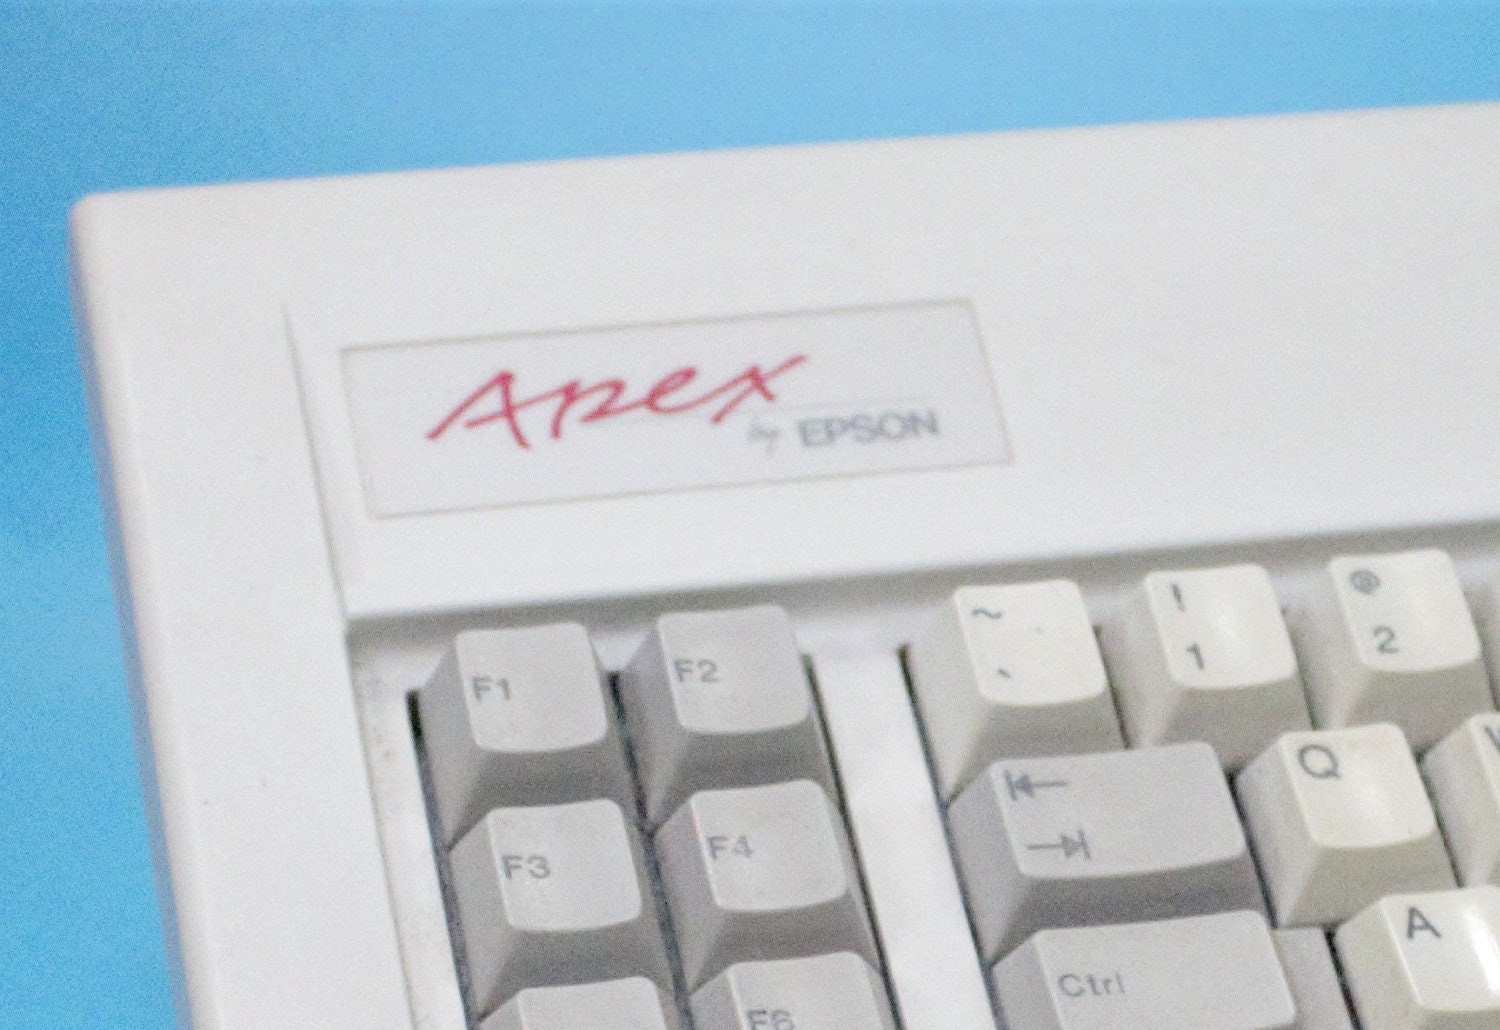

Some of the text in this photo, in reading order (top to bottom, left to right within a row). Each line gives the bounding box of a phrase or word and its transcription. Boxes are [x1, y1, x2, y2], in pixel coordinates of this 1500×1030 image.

[427, 355, 809, 450] Apex
[800, 407, 940, 449] EPSON
[1374, 626, 1398, 655] 2
[1186, 644, 1205, 670] 1
[674, 658, 718, 684] F2
[472, 677, 511, 703] F1
[1300, 743, 1341, 780] Q
[706, 834, 756, 860] F4
[502, 855, 551, 881] F3
[1405, 907, 1441, 940] A
[1057, 972, 1126, 998] Ctrl
